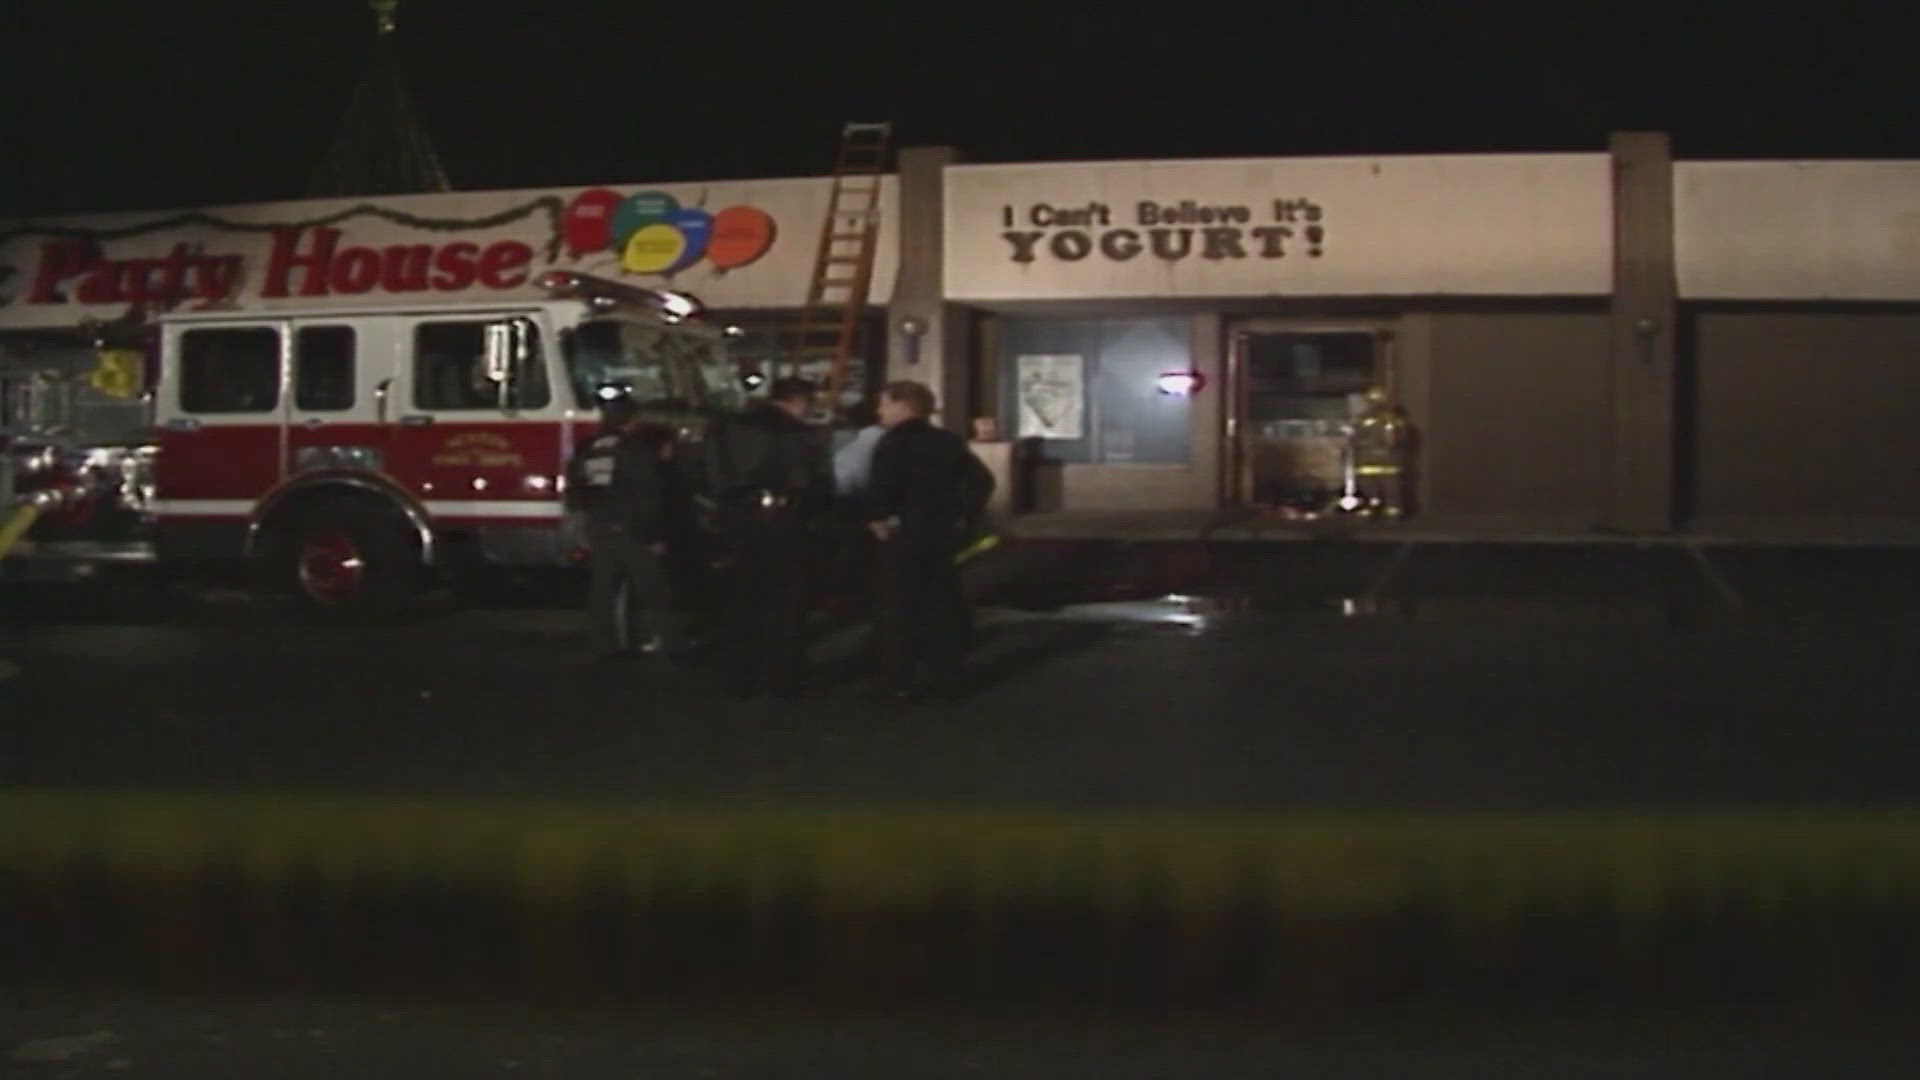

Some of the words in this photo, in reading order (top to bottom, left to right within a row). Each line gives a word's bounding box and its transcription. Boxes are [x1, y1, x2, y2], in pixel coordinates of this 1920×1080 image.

[1003, 204, 1013, 228] I
[1030, 203, 1111, 227] Can't
[1137, 200, 1251, 226] Believe
[1273, 198, 1323, 223] It's
[1002, 226, 1325, 264] YOGURT!
[26, 237, 242, 310] Party
[260, 226, 533, 298] House
